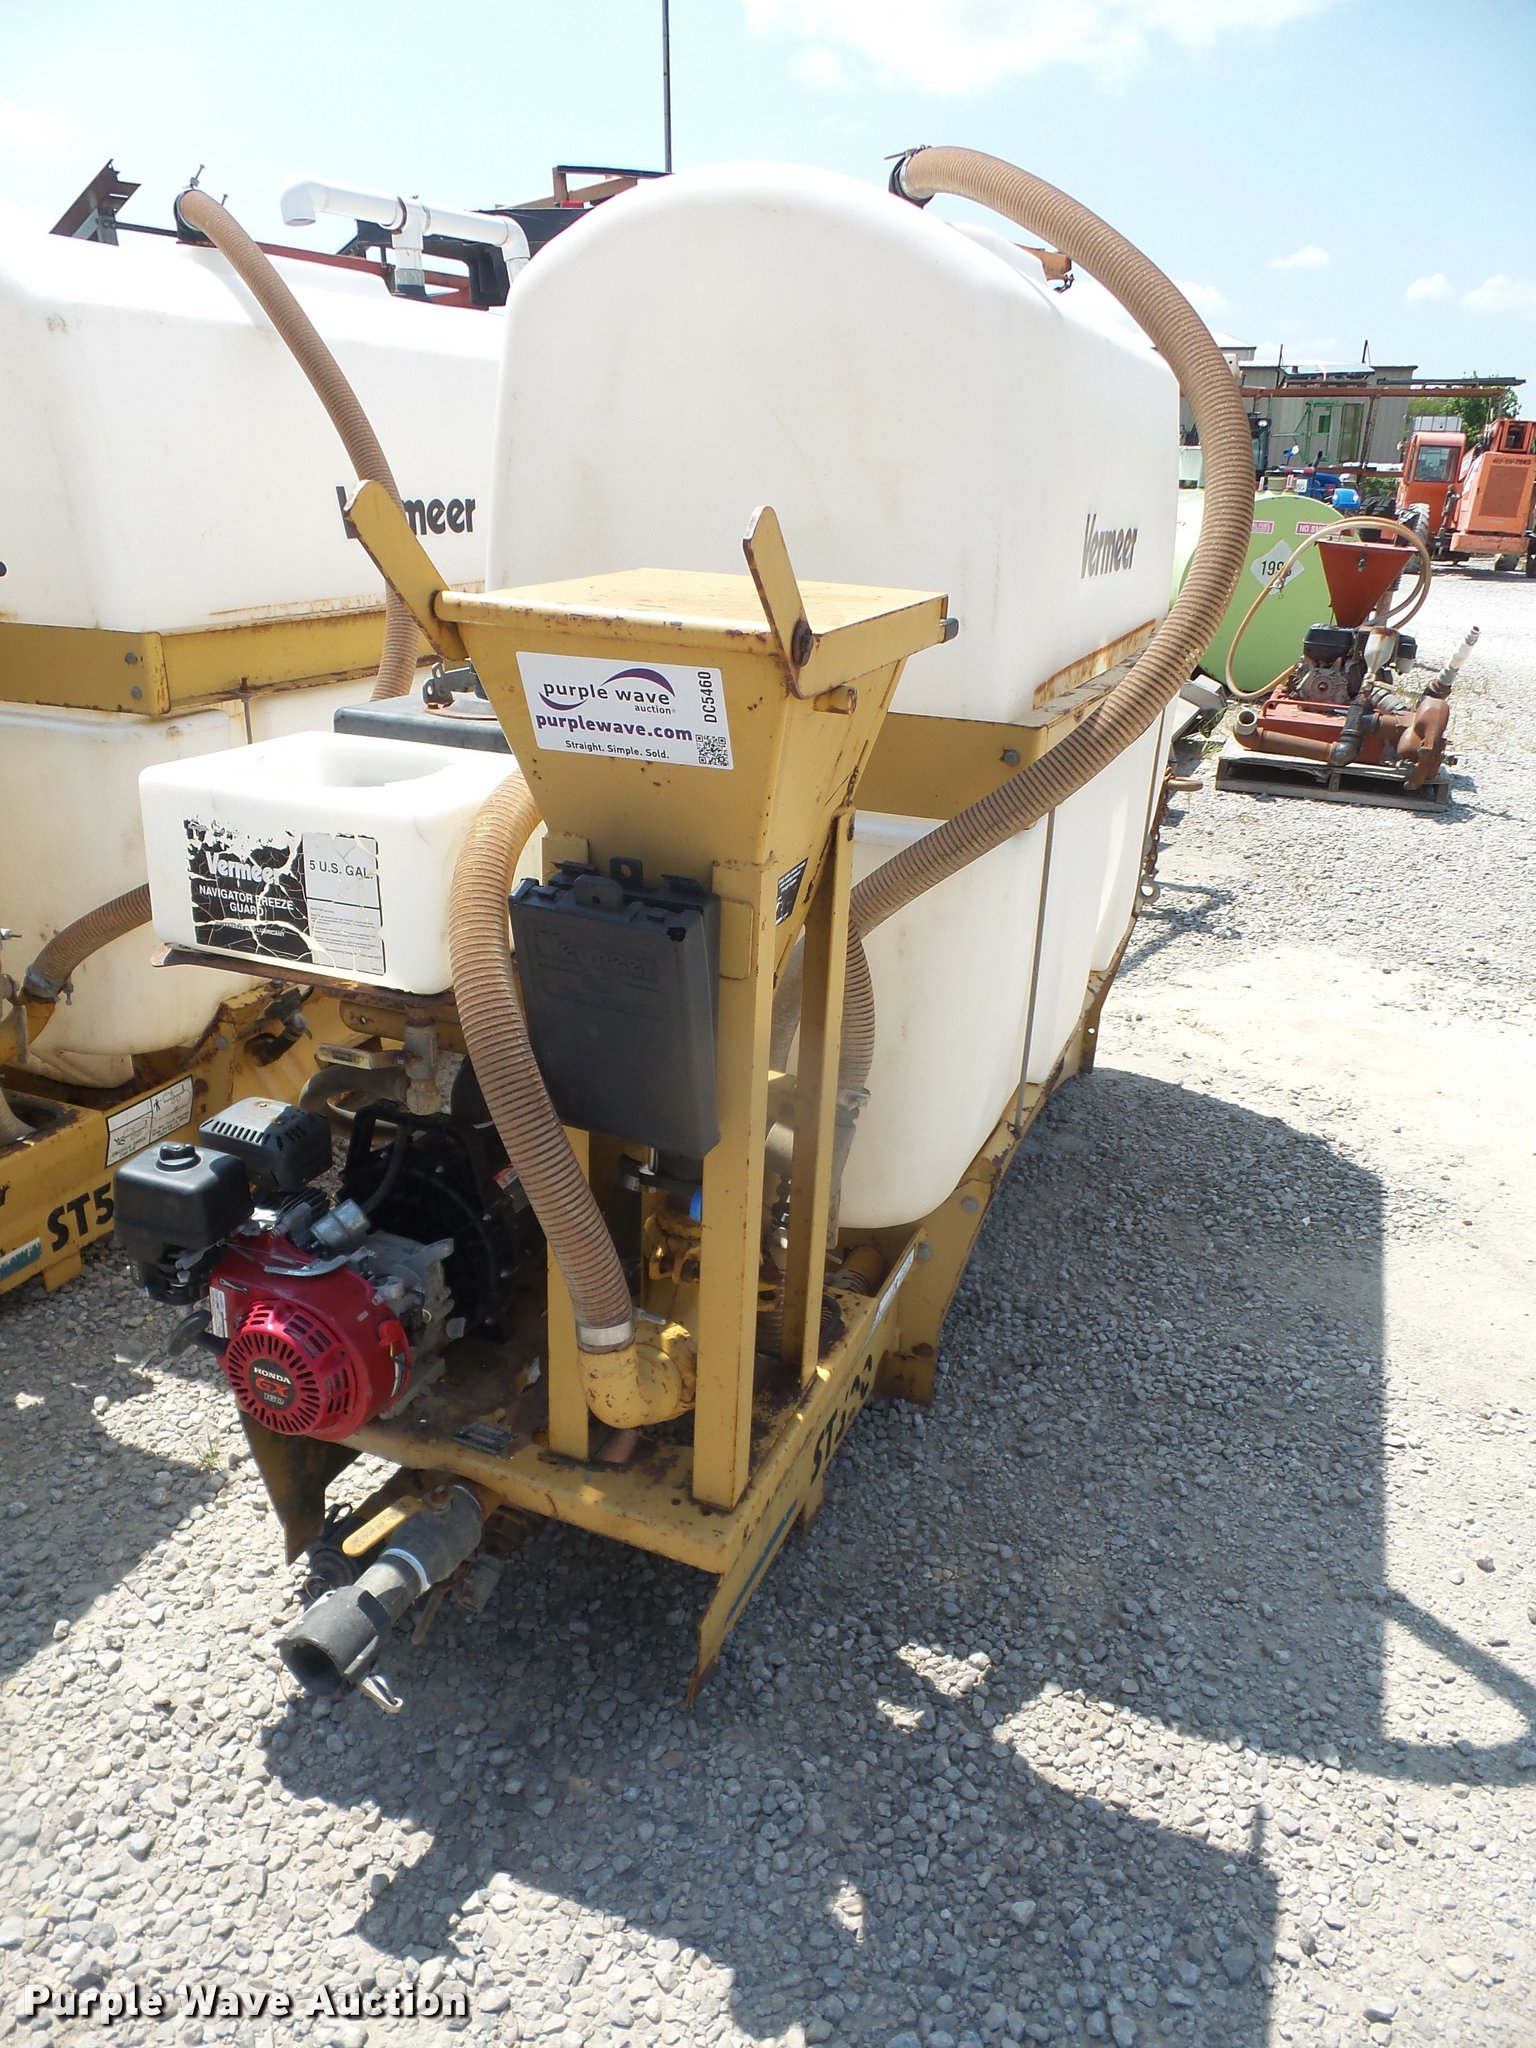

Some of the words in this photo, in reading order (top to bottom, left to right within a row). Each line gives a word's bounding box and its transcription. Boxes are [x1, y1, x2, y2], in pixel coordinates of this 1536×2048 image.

[1299, 524, 1309, 532] NO
[1081, 513, 1138, 579] Vermeer
[1261, 560, 1292, 578] 199
[543, 682, 608, 701] purple
[615, 688, 670, 705] wave
[697, 671, 718, 723] DC5460
[634, 704, 672, 715] auction
[535, 713, 693, 741] purplewave.com
[565, 739, 605, 753] Straight.
[607, 744, 643, 756] Simple.
[645, 748, 670, 759] Sold.
[205, 851, 281, 885] Vermeer
[309, 859, 316, 870] 5
[319, 860, 342, 874] U.S.
[345, 865, 373, 879] GAL.
[199, 884, 254, 904] NAVIGATOR
[229, 902, 264, 916] GUARD
[253, 1366, 292, 1385] HONDA
[255, 1377, 290, 1399] GX
